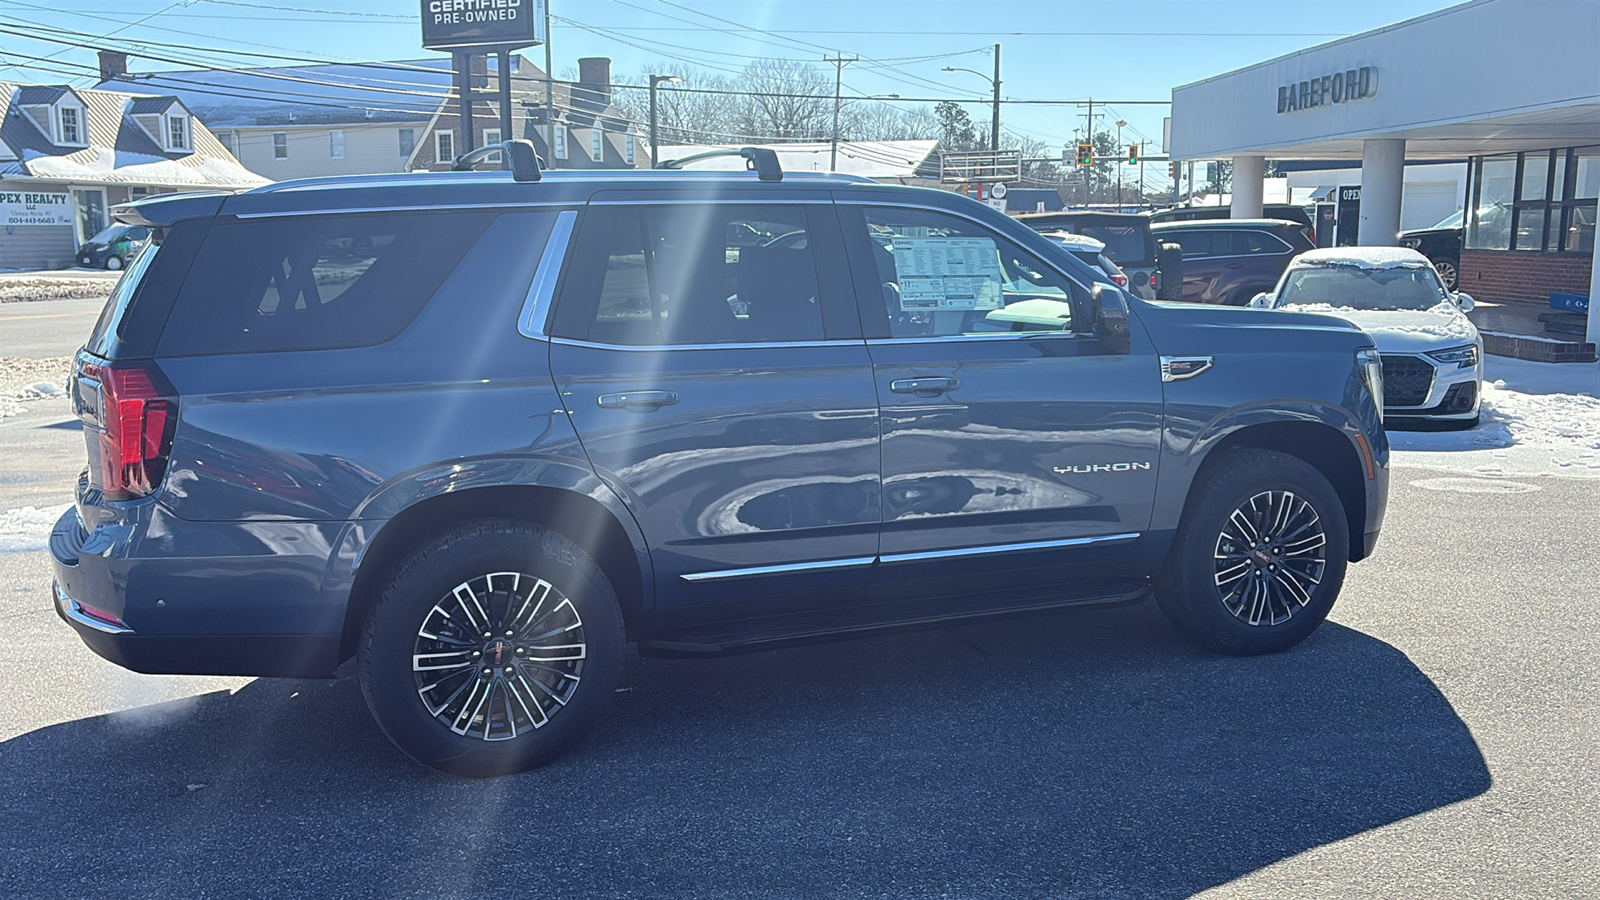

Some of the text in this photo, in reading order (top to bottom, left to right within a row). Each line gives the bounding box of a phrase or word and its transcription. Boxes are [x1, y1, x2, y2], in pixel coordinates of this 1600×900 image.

[429, 0, 521, 13] CERTIFIED
[434, 8, 517, 25] PRE-OWNED
[1277, 66, 1379, 114] BAREFORD
[25, 193, 66, 204] REALTY
[1053, 461, 1151, 474] YUKON
